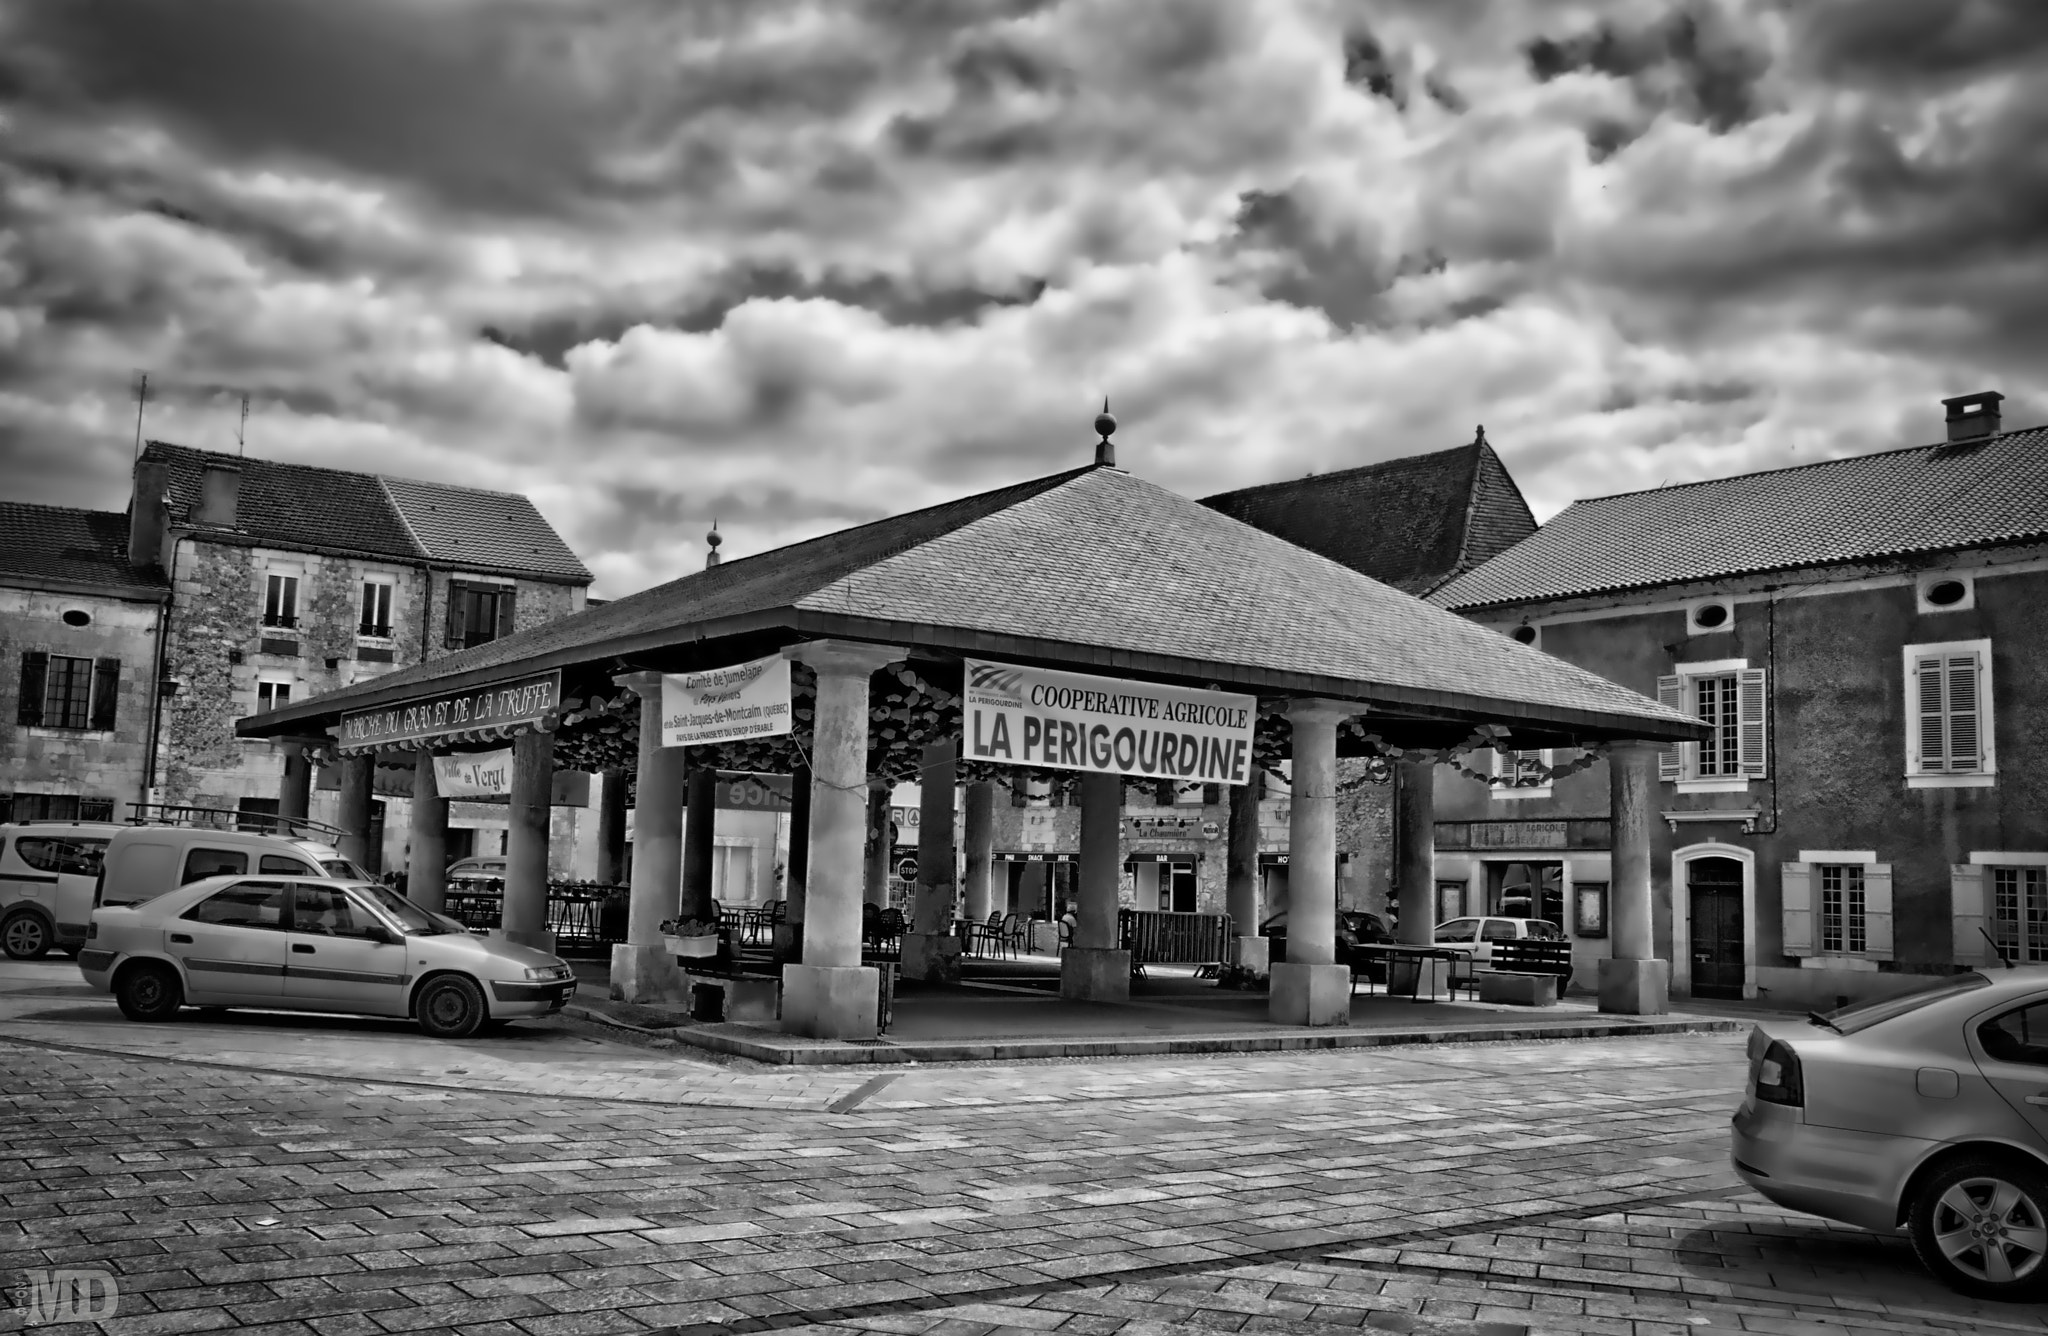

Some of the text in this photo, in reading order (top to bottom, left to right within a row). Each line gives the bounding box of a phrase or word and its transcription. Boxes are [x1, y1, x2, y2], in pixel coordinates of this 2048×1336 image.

[686, 665, 762, 689] Comité de jumelage
[385, 710, 400, 735] DU
[404, 704, 432, 734] GRAS
[434, 701, 451, 727] ET
[452, 697, 470, 725] DE
[474, 693, 493, 721] LA
[497, 682, 552, 717] TRUFFE
[978, 697, 1023, 709] PERIGOURDINE
[1031, 684, 1248, 729] COOPERATIVE AGRICOLE
[673, 704, 762, 728] Saint-Jacques-de-Montcalm
[676, 733, 687, 742] PAYS
[687, 732, 694, 741] DE
[694, 732, 700, 740] LA
[700, 731, 717, 740] FRAISE
[718, 730, 724, 738] ET
[725, 729, 732, 737] DU
[733, 726, 749, 735] SIROP
[974, 709, 1248, 781] LA PERIGOURDINE
[464, 773, 472, 784] de
[472, 764, 506, 792] Vergt
[1526, 823, 1566, 833] AGRICOLE
[1156, 854, 1168, 862] BAR
[900, 866, 918, 875] STOP
